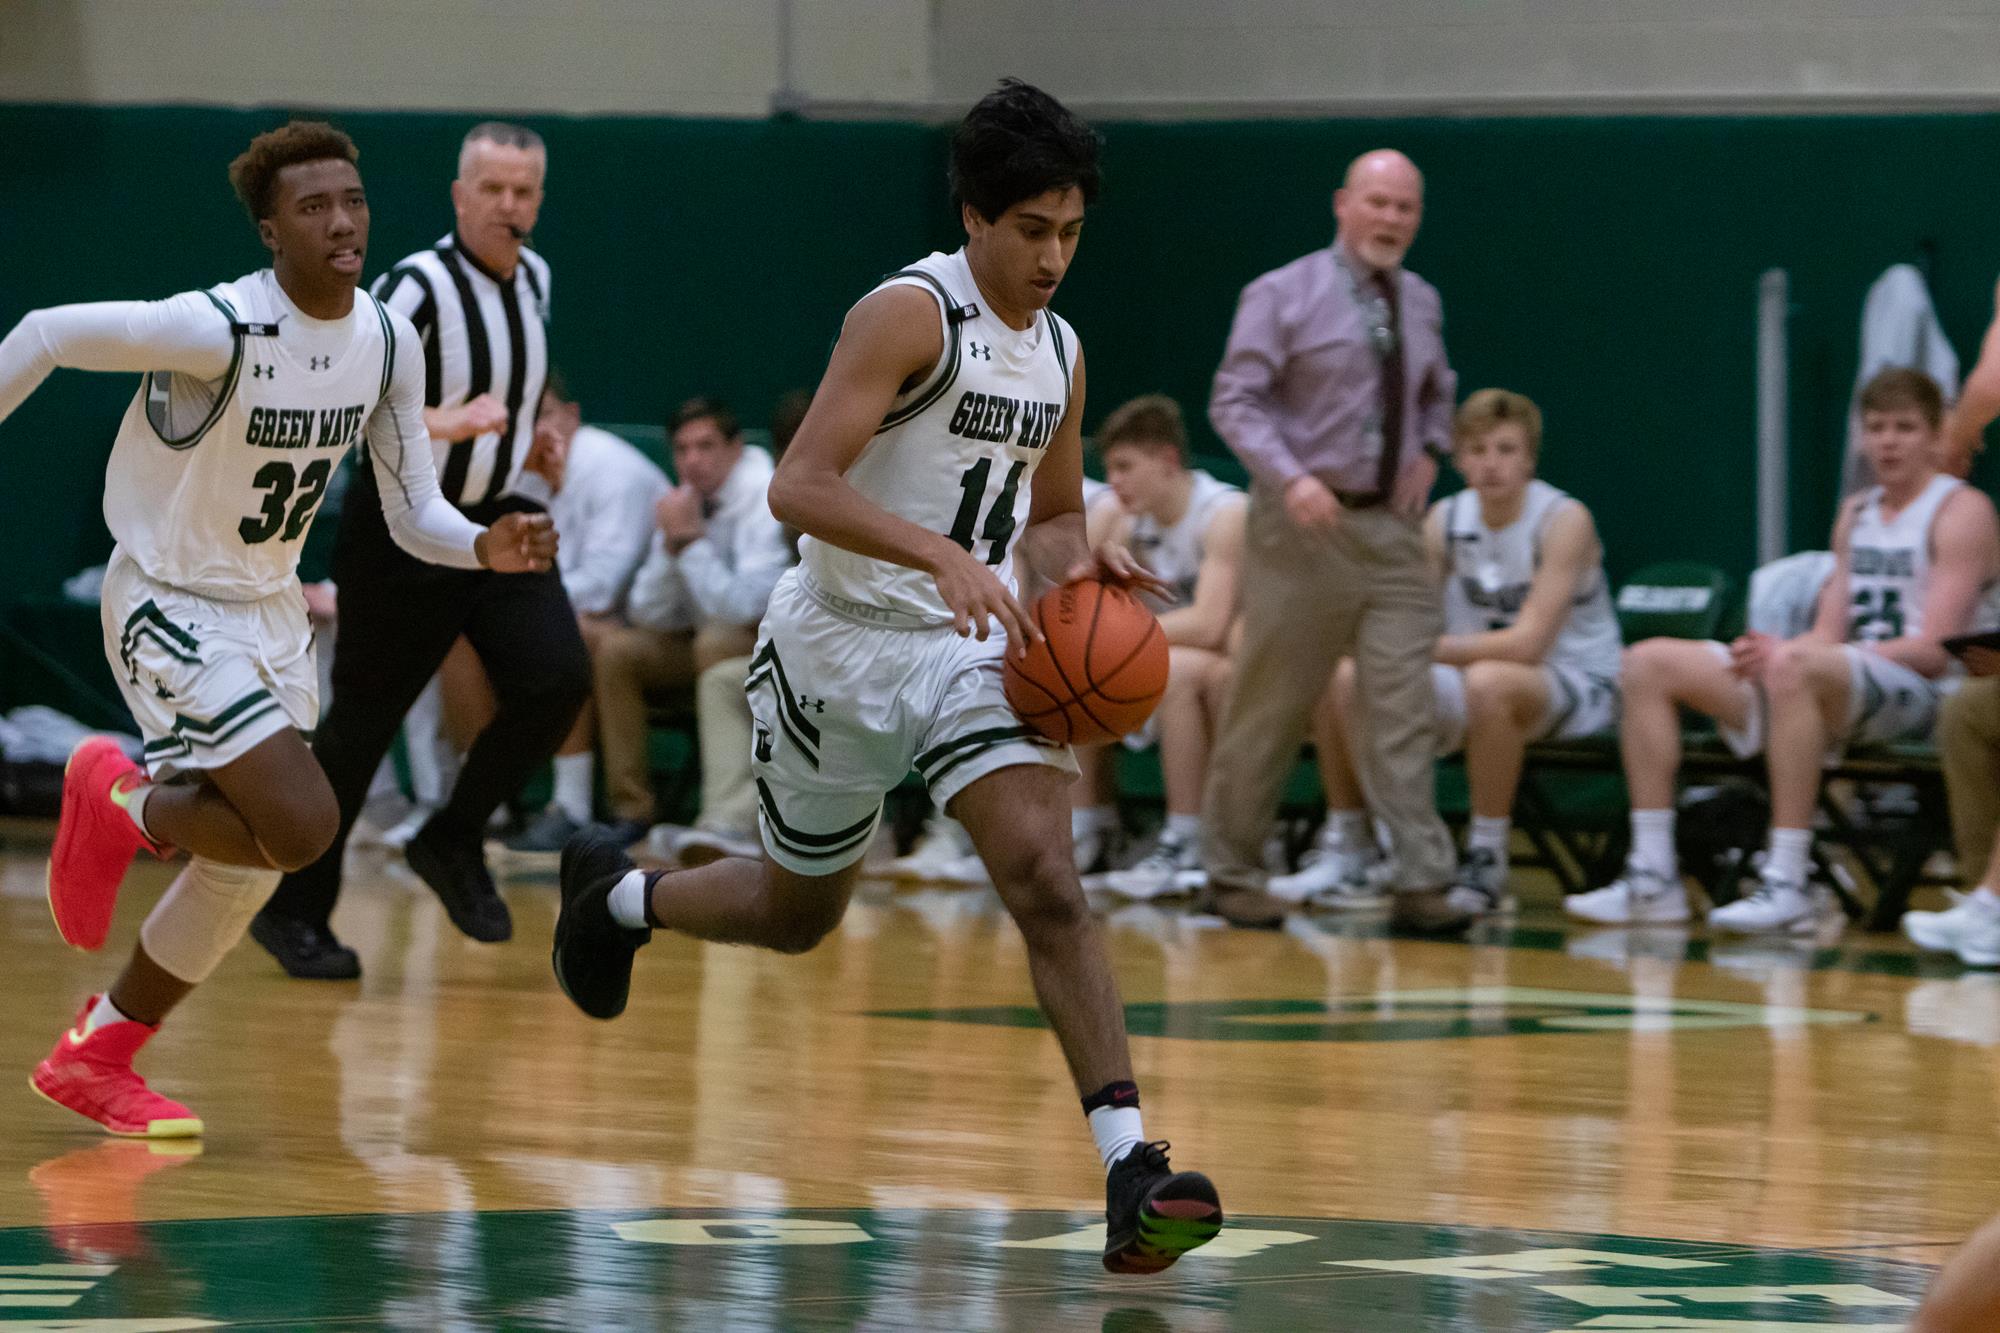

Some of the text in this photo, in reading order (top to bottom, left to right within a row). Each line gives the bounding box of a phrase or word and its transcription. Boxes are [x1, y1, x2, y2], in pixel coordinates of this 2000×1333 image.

[246, 404, 365, 448] GREEN WAVE
[949, 390, 1019, 443] GREEN
[237, 458, 331, 544] 32
[945, 457, 1028, 565] 14
